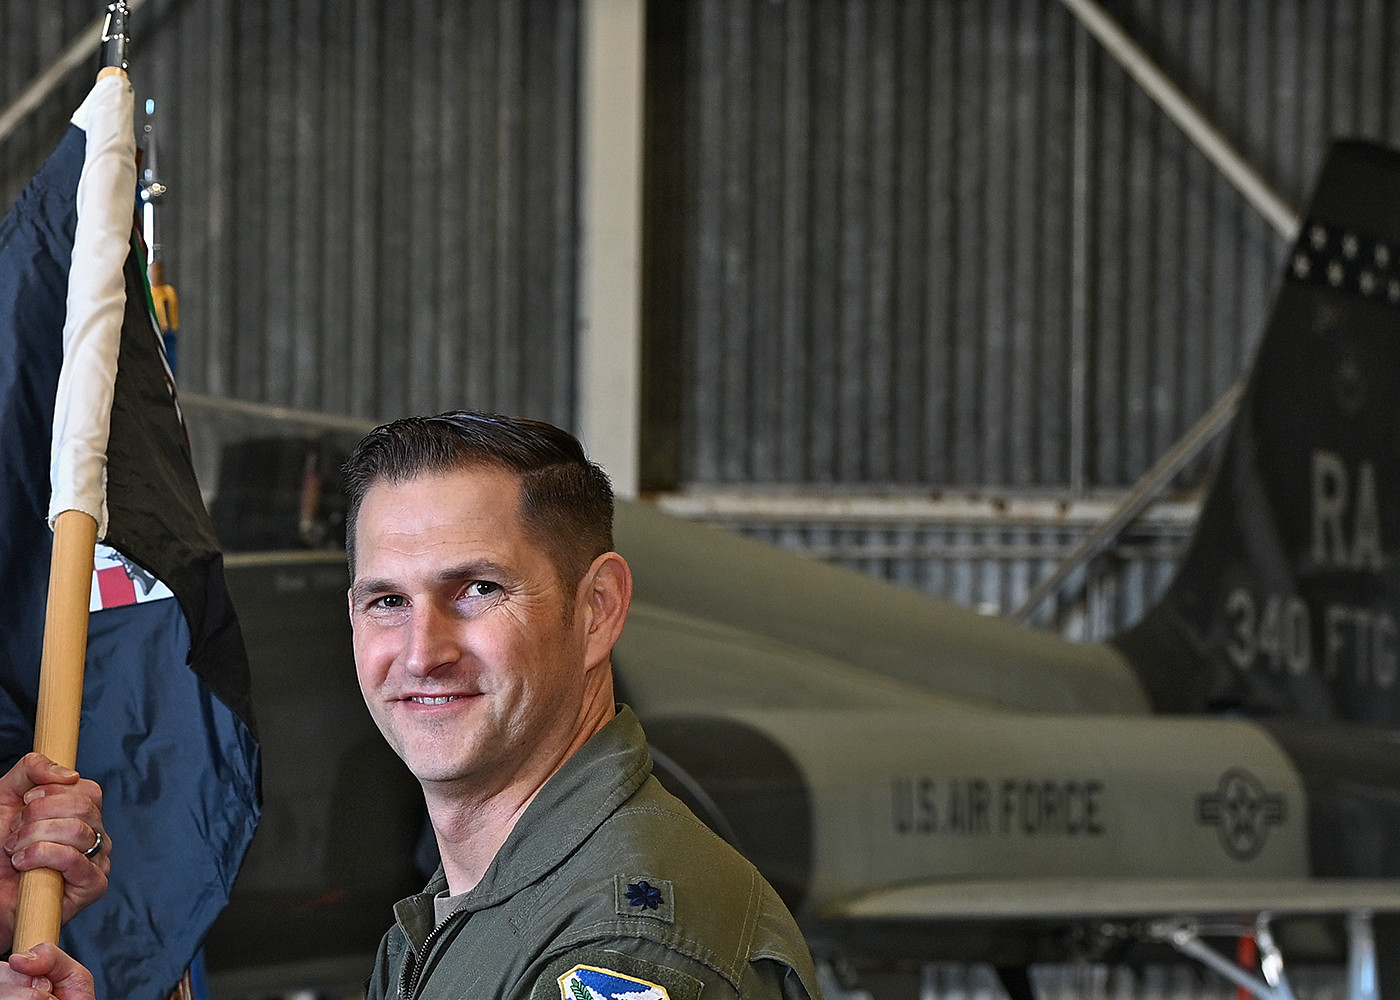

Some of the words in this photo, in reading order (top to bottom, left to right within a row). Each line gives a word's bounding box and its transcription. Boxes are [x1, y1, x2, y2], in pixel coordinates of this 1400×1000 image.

[1312, 451, 1383, 570] RA
[1226, 588, 1311, 675] 340
[949, 777, 991, 835] AIR
[1000, 778, 1105, 838] FORCE
